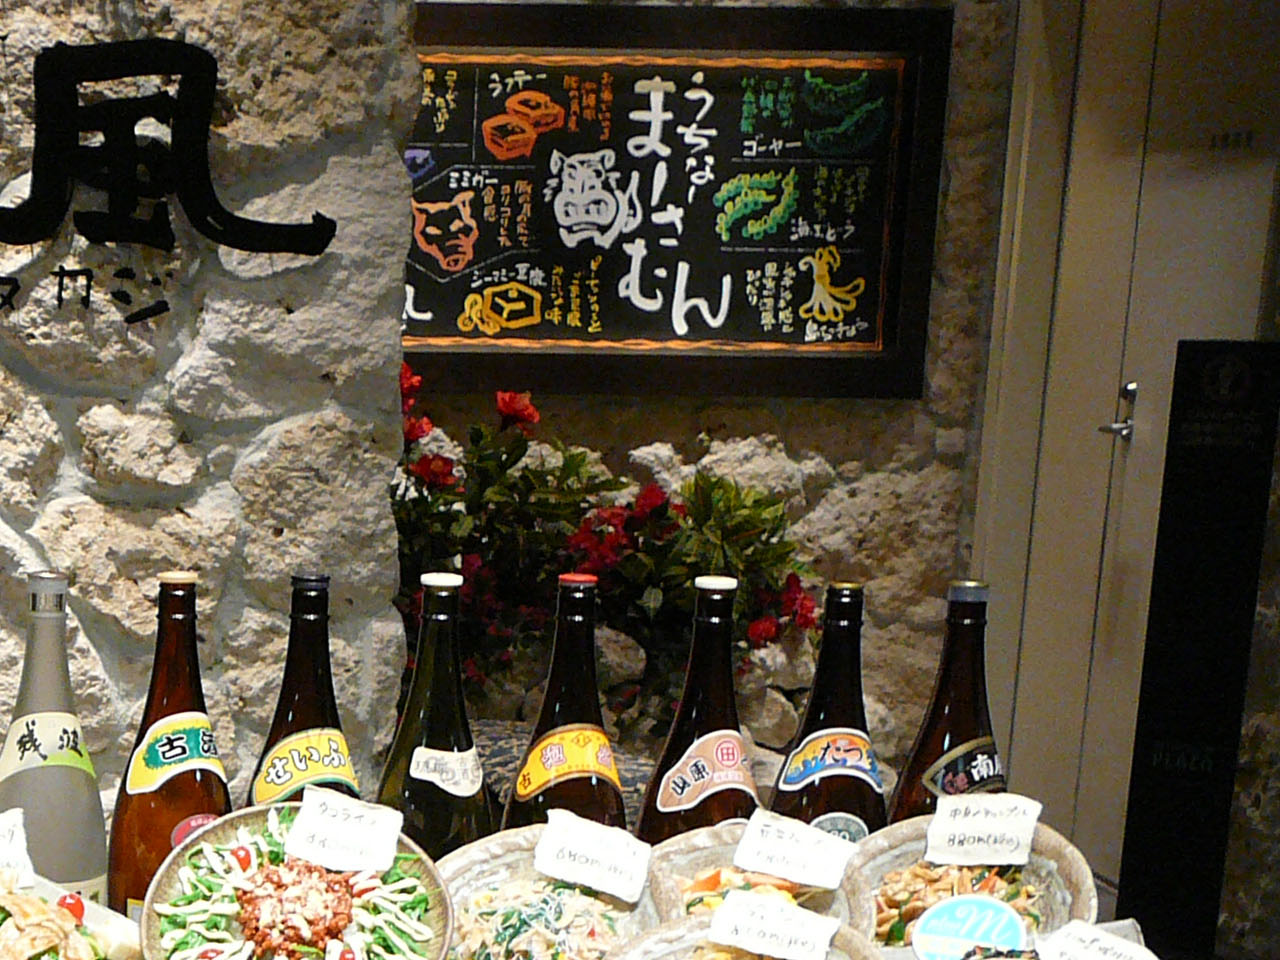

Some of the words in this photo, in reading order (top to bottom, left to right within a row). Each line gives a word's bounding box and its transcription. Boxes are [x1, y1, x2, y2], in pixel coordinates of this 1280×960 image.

[489, 70, 547, 98] ラフテー
[743, 133, 802, 156] ゴーヤー
[449, 170, 498, 189] ミミガー
[16, 719, 84, 762] 残波
